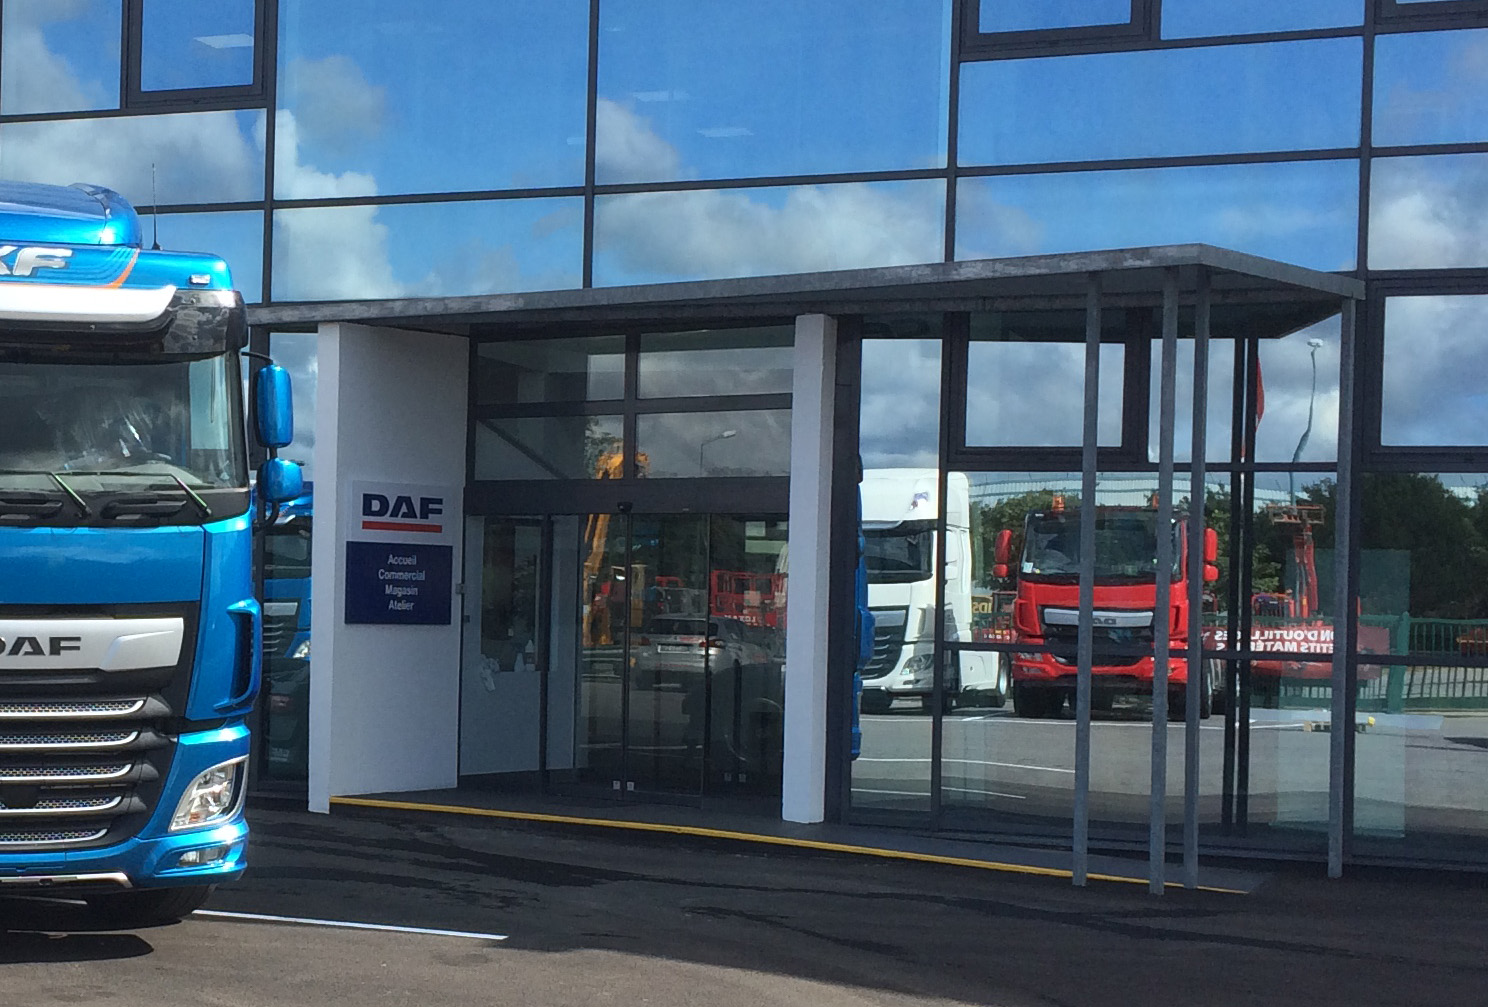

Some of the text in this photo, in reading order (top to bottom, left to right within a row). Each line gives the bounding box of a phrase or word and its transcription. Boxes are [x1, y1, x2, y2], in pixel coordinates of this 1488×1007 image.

[363, 493, 443, 519] DAF
[387, 554, 417, 565] Accueil
[378, 568, 425, 581] Commercial
[385, 584, 418, 598] Magasin
[388, 599, 414, 610] Atelier
